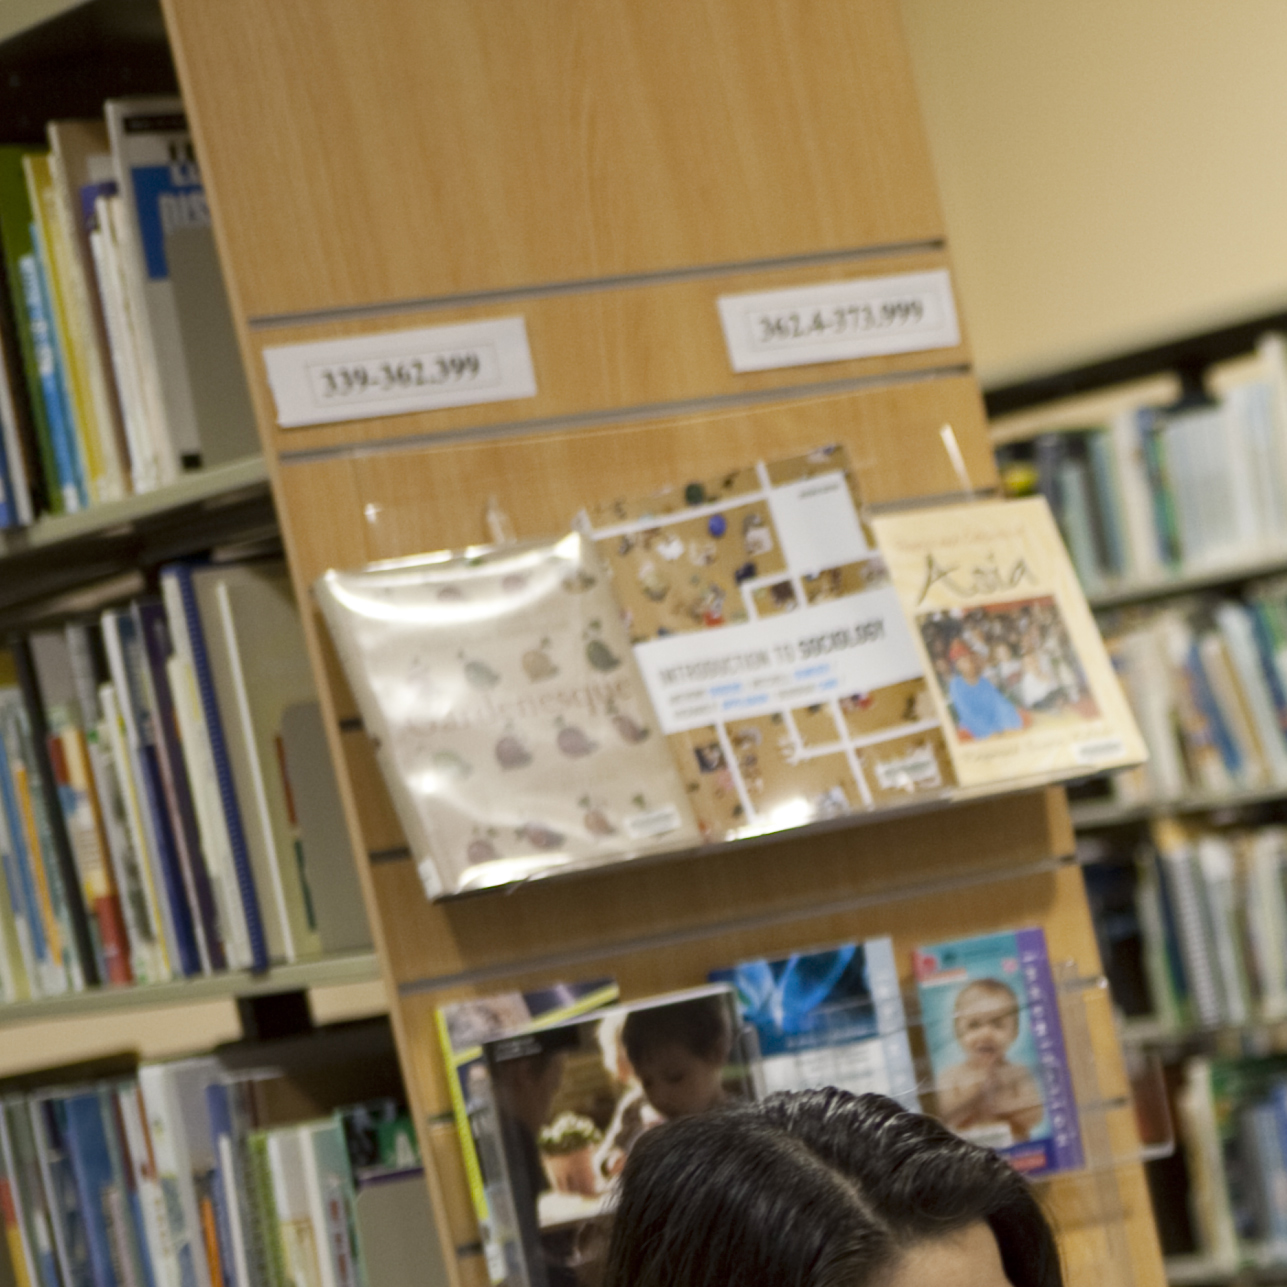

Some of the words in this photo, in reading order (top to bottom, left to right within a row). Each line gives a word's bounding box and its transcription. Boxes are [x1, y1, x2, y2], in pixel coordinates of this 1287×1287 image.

[320, 352, 481, 398] 339-362.399
[659, 651, 771, 686] INTRODUCTION
[773, 642, 795, 665] TO
[798, 619, 886, 660] SOCIOLOGY
